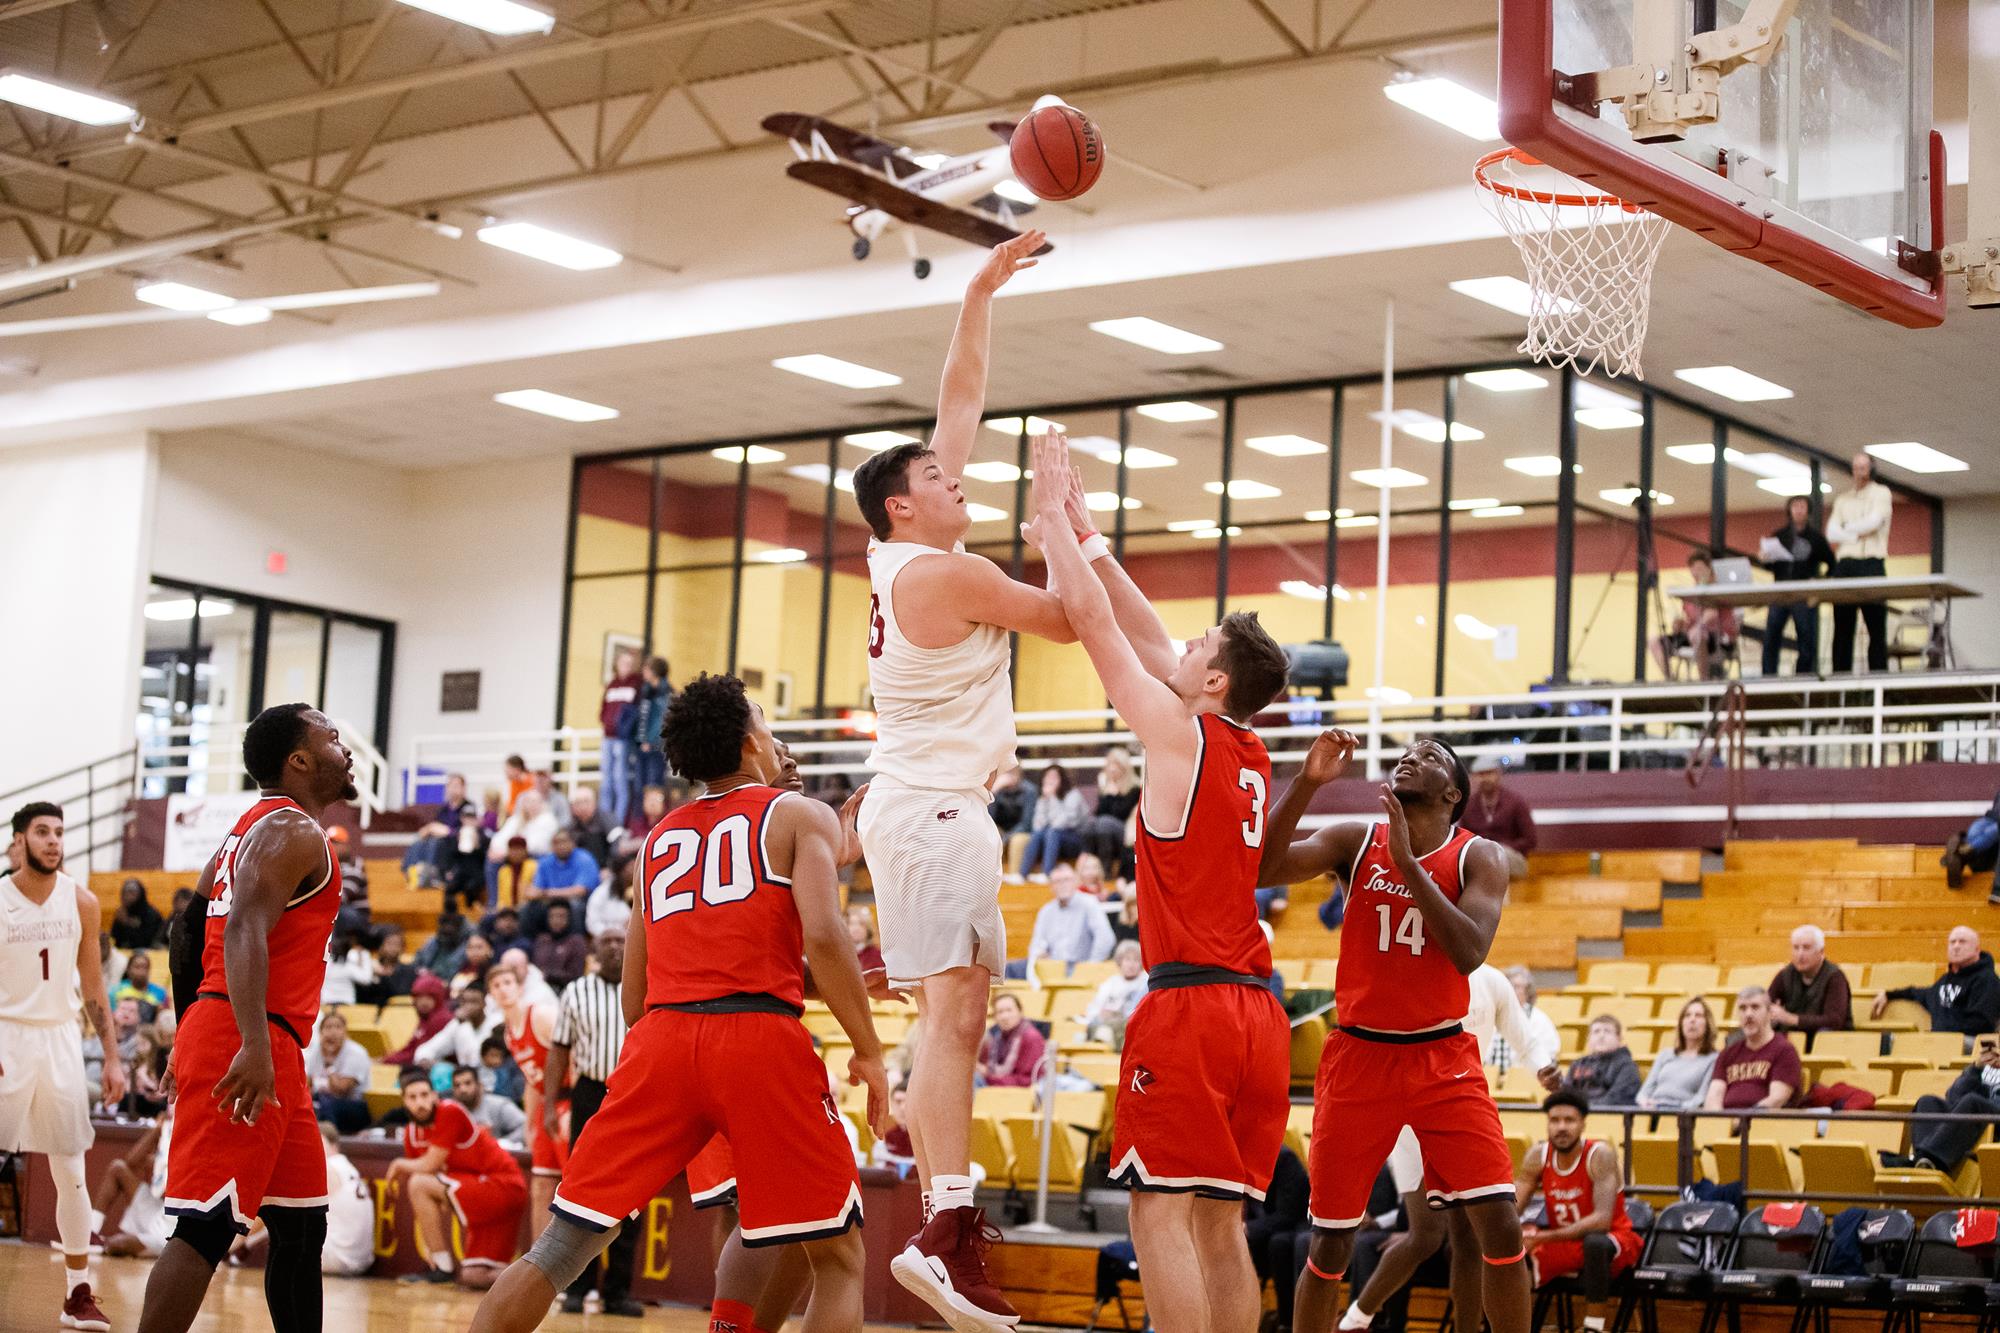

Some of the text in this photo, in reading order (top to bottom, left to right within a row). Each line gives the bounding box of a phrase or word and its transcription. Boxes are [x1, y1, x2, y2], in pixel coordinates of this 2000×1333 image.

[1238, 766, 1266, 850] 3
[650, 813, 757, 925] 20
[1375, 903, 1426, 956] 14
[38, 947, 50, 982] 1
